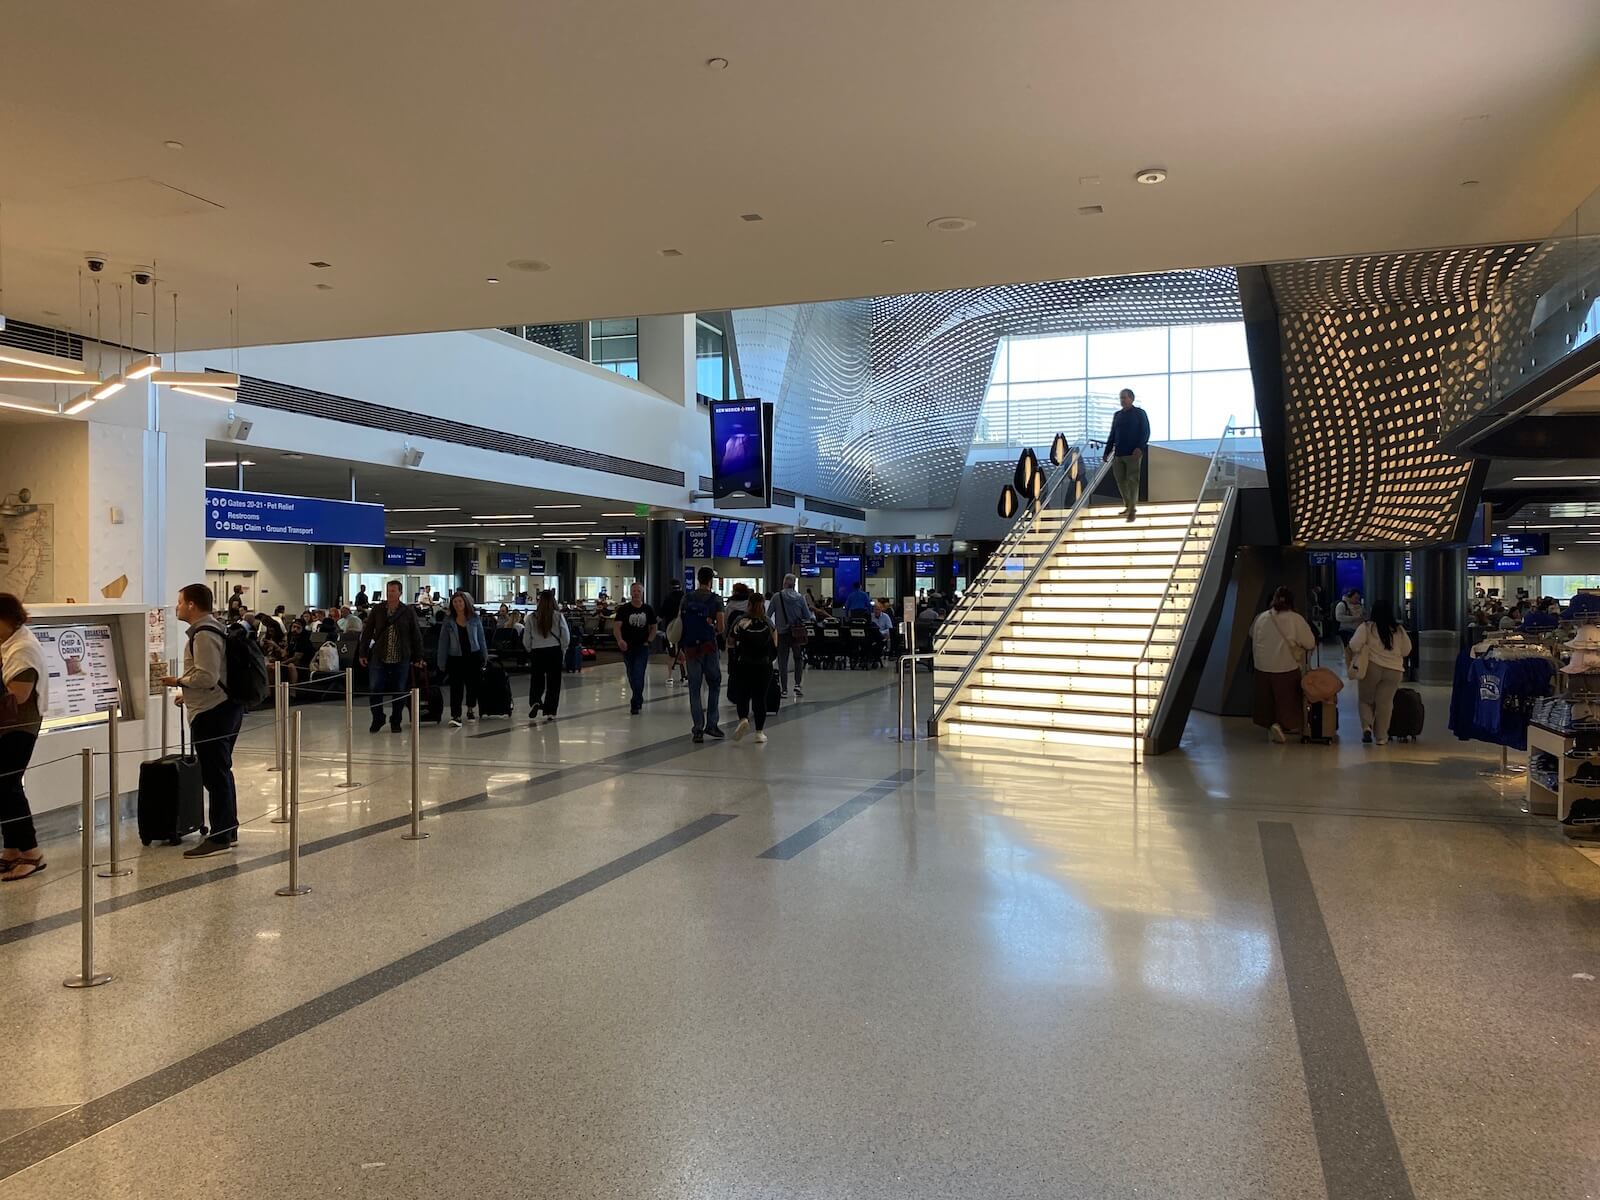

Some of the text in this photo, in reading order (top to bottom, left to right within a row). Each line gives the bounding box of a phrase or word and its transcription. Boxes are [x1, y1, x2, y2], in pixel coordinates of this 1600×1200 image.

[228, 499, 246, 508] Gates
[228, 512, 260, 520] Restrooms
[231, 522, 314, 534] Bag Claim Ground Transport
[692, 538, 704, 548] 24
[692, 548, 704, 557] 22
